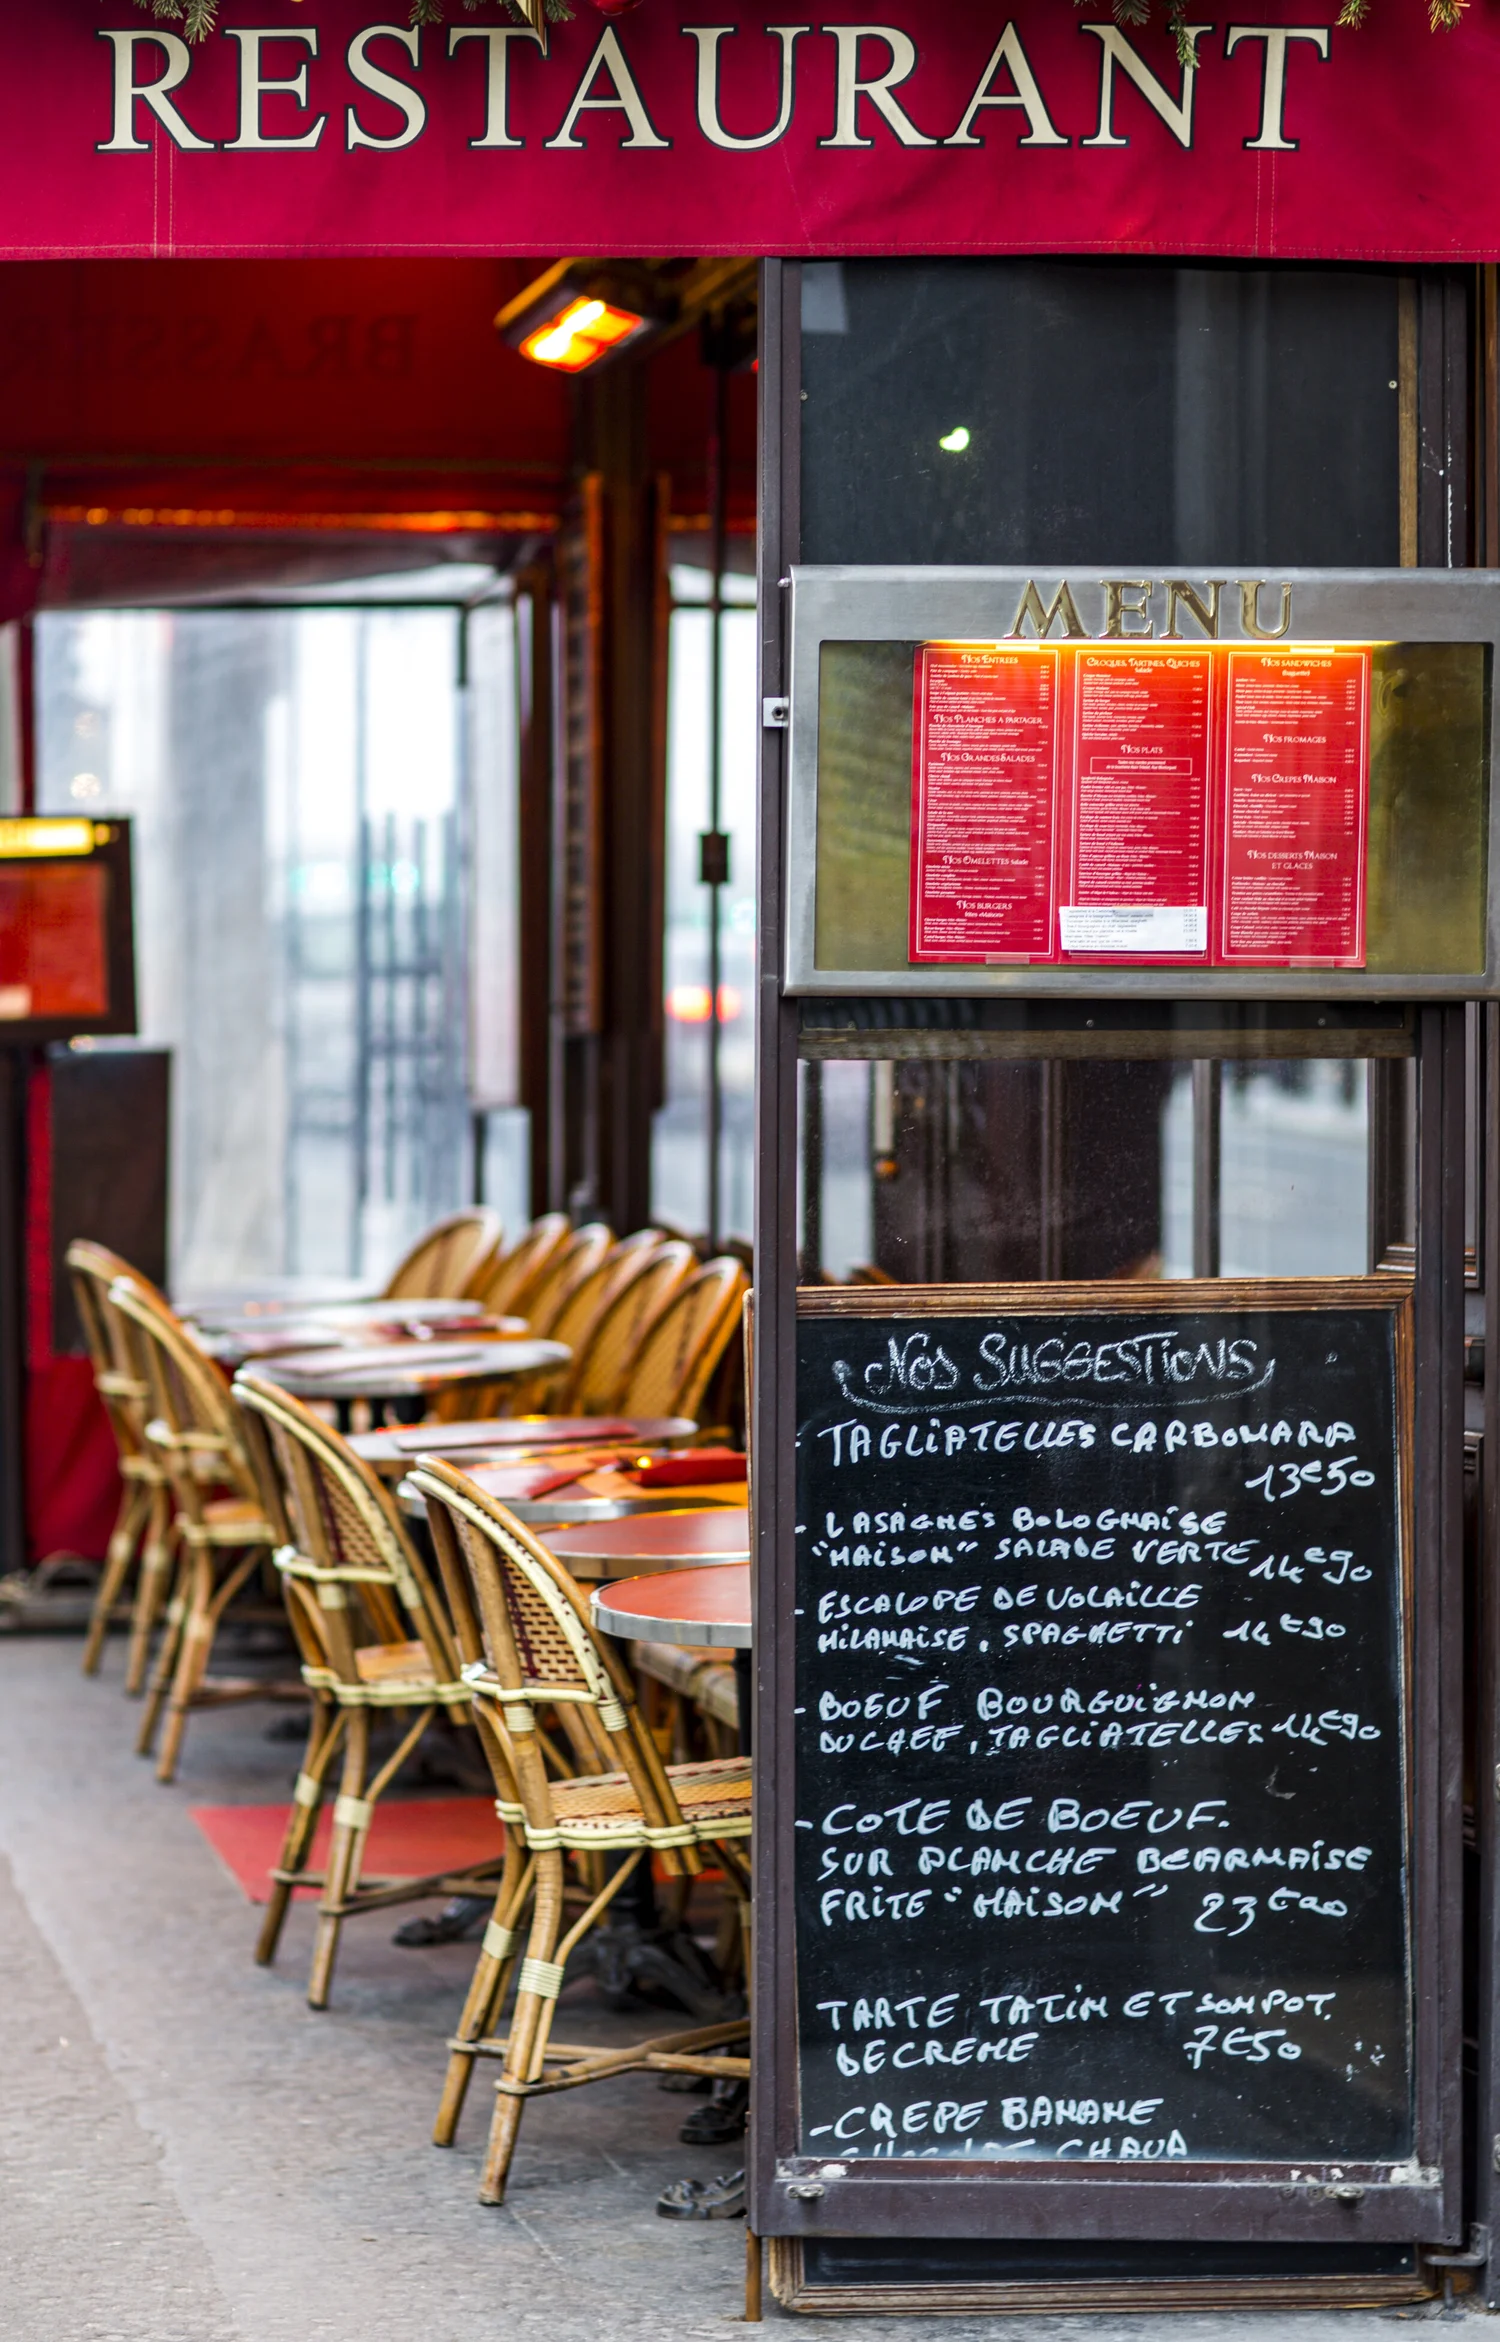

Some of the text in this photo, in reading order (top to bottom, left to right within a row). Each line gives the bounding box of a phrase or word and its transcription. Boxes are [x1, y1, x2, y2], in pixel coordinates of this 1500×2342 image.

[95, 22, 1332, 152] RESTAURANT
[1003, 579, 1293, 640] MENU
[1132, 1539, 1260, 1565] VERTE
[818, 1684, 950, 1721] BOEUF
[966, 1796, 1033, 1831] DE
[816, 1846, 894, 1881] SUR
[918, 1845, 1117, 1876] PLANCHE
[816, 1993, 960, 2031] TARTE
